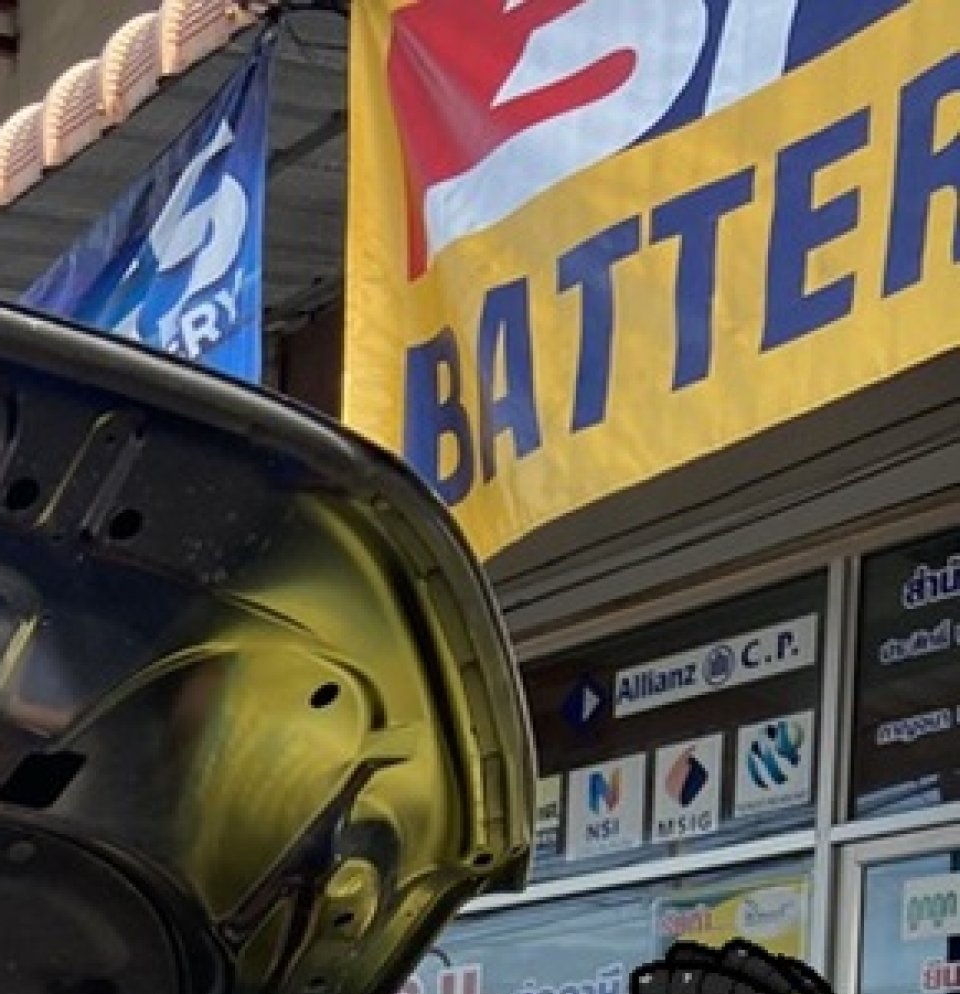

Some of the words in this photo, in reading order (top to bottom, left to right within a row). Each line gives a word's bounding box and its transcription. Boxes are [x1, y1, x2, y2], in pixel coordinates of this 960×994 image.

[617, 661, 696, 705] Allianz
[585, 816, 621, 842] NSI
[657, 810, 713, 837] MSIG
